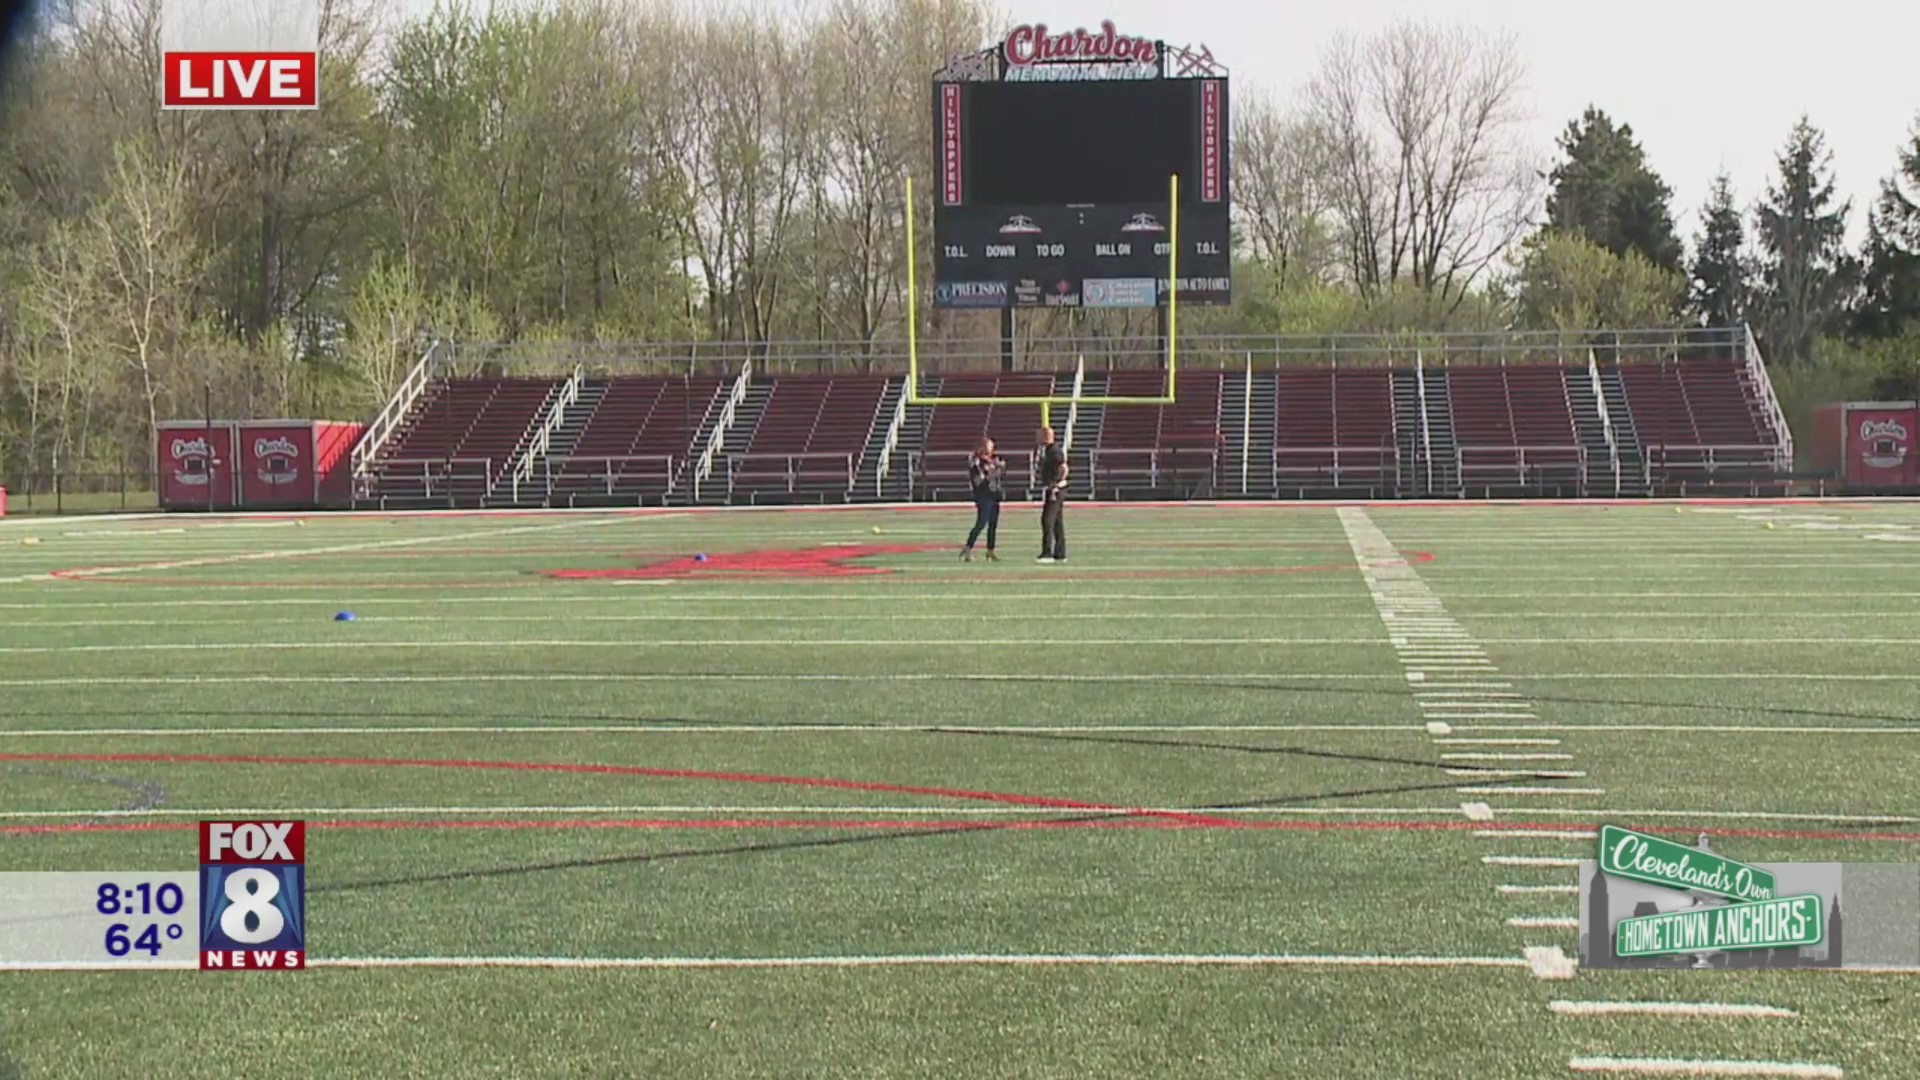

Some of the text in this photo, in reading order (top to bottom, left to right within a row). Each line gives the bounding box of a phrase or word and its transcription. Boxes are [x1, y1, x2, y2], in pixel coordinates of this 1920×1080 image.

[1005, 20, 1157, 65] Chardon
[946, 87, 956, 203] HILLTOPPERS
[1206, 83, 1215, 199] HILLTOPPERS
[985, 245, 1016, 257] DOWN
[1036, 243, 1065, 257] TO GO
[1095, 243, 1131, 256] BALL ON
[951, 282, 1007, 296] PRECISION
